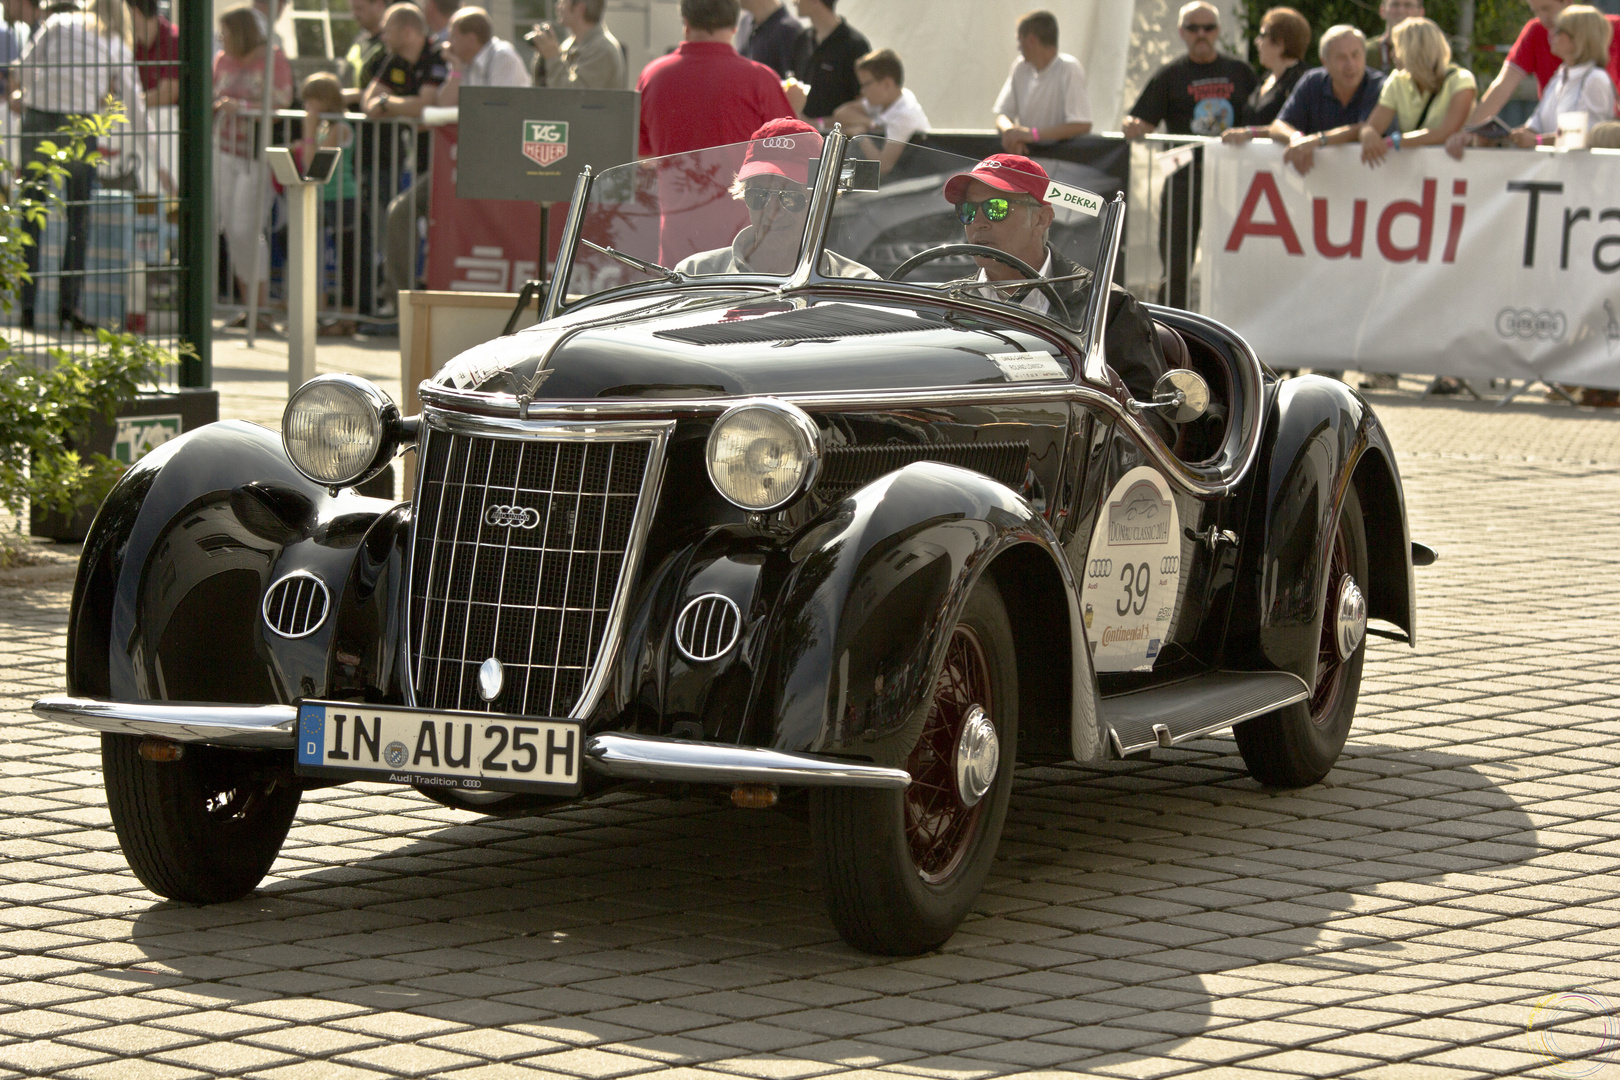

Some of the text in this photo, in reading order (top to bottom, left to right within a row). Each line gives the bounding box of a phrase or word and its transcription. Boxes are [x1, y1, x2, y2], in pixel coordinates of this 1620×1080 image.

[531, 124, 561, 142] TAG
[526, 144, 565, 163] HEUER
[1063, 192, 1097, 210] DEKRA
[1224, 169, 1620, 274] Audi Tra
[1110, 520, 1168, 541] DONAU CLASSIC 2014
[1087, 582, 1098, 590] Audi
[1116, 562, 1151, 617] 39
[1101, 624, 1145, 648] Continental
[306, 741, 316, 755] D
[327, 714, 574, 776] IN AU 25H
[389, 773, 458, 786] Audi Tradition
